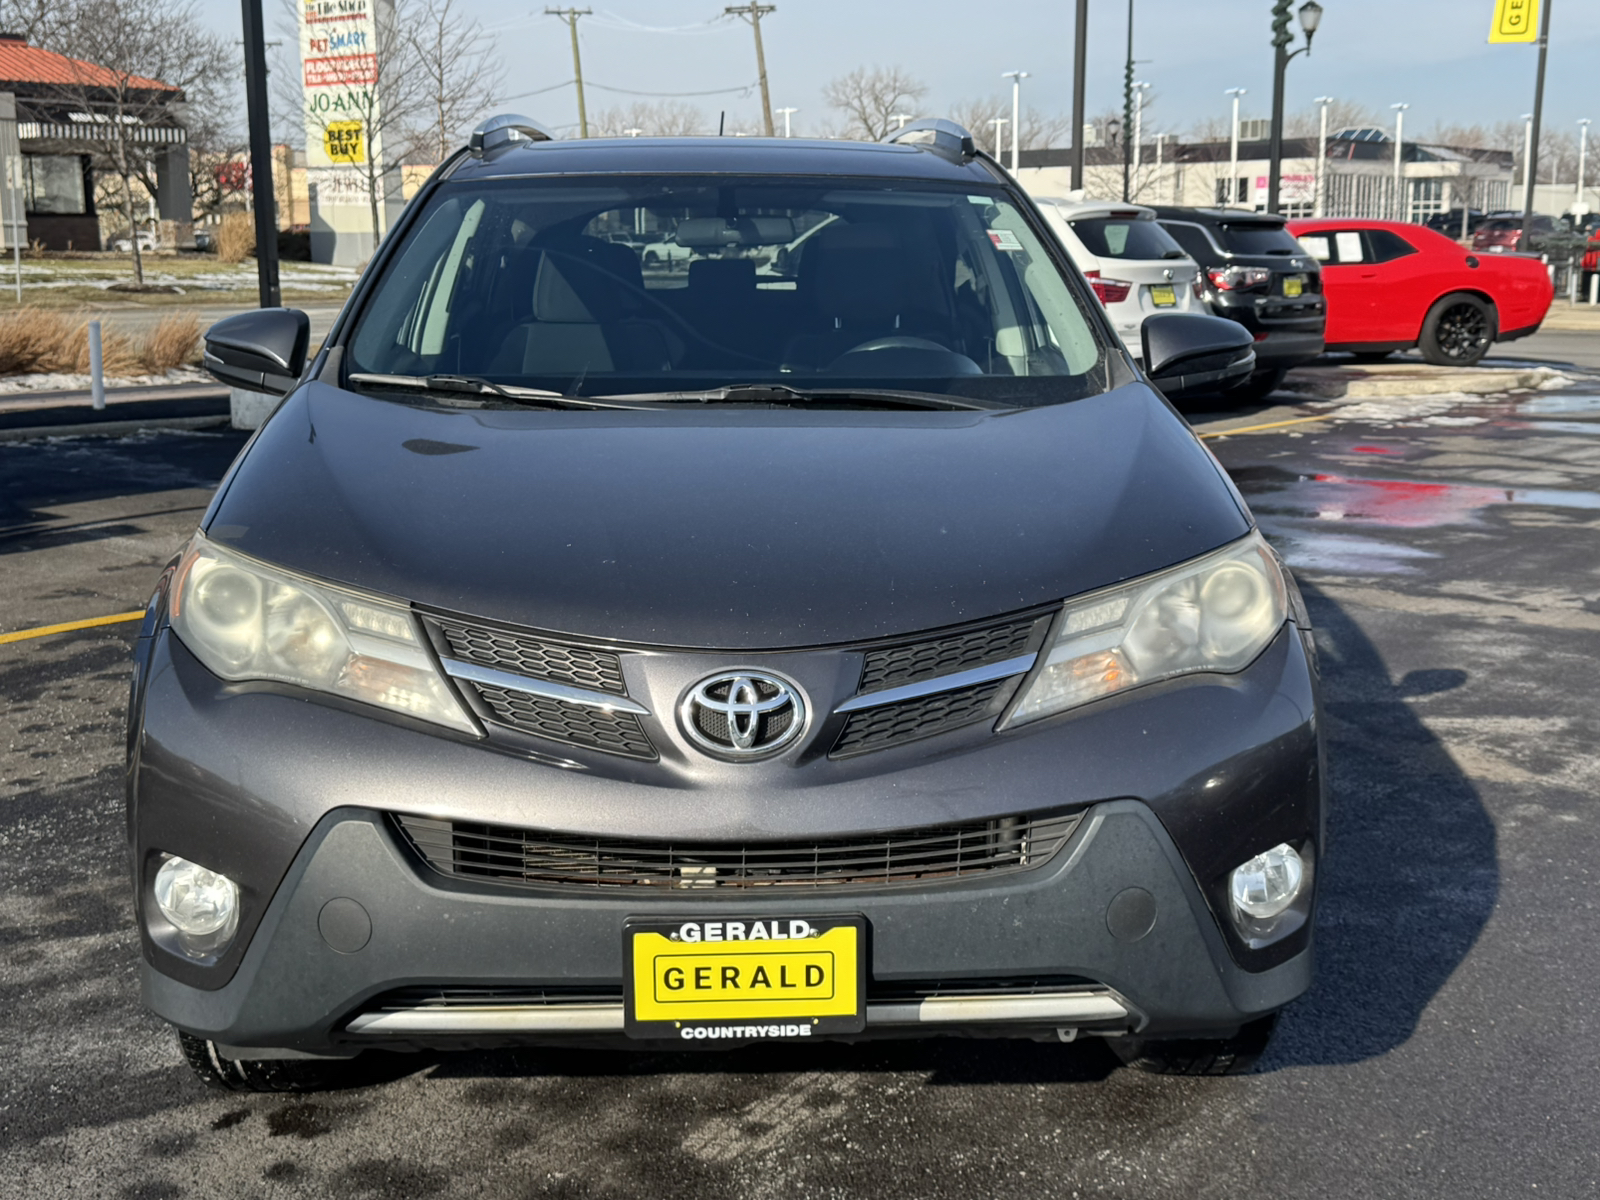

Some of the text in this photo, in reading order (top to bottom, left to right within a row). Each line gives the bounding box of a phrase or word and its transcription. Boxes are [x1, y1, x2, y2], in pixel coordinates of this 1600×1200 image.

[328, 129, 361, 141] BEST
[330, 143, 358, 155] BUY
[679, 920, 810, 942] GERALD
[663, 964, 825, 991] GERALD
[681, 1024, 812, 1039] COUNTRYSIDE
